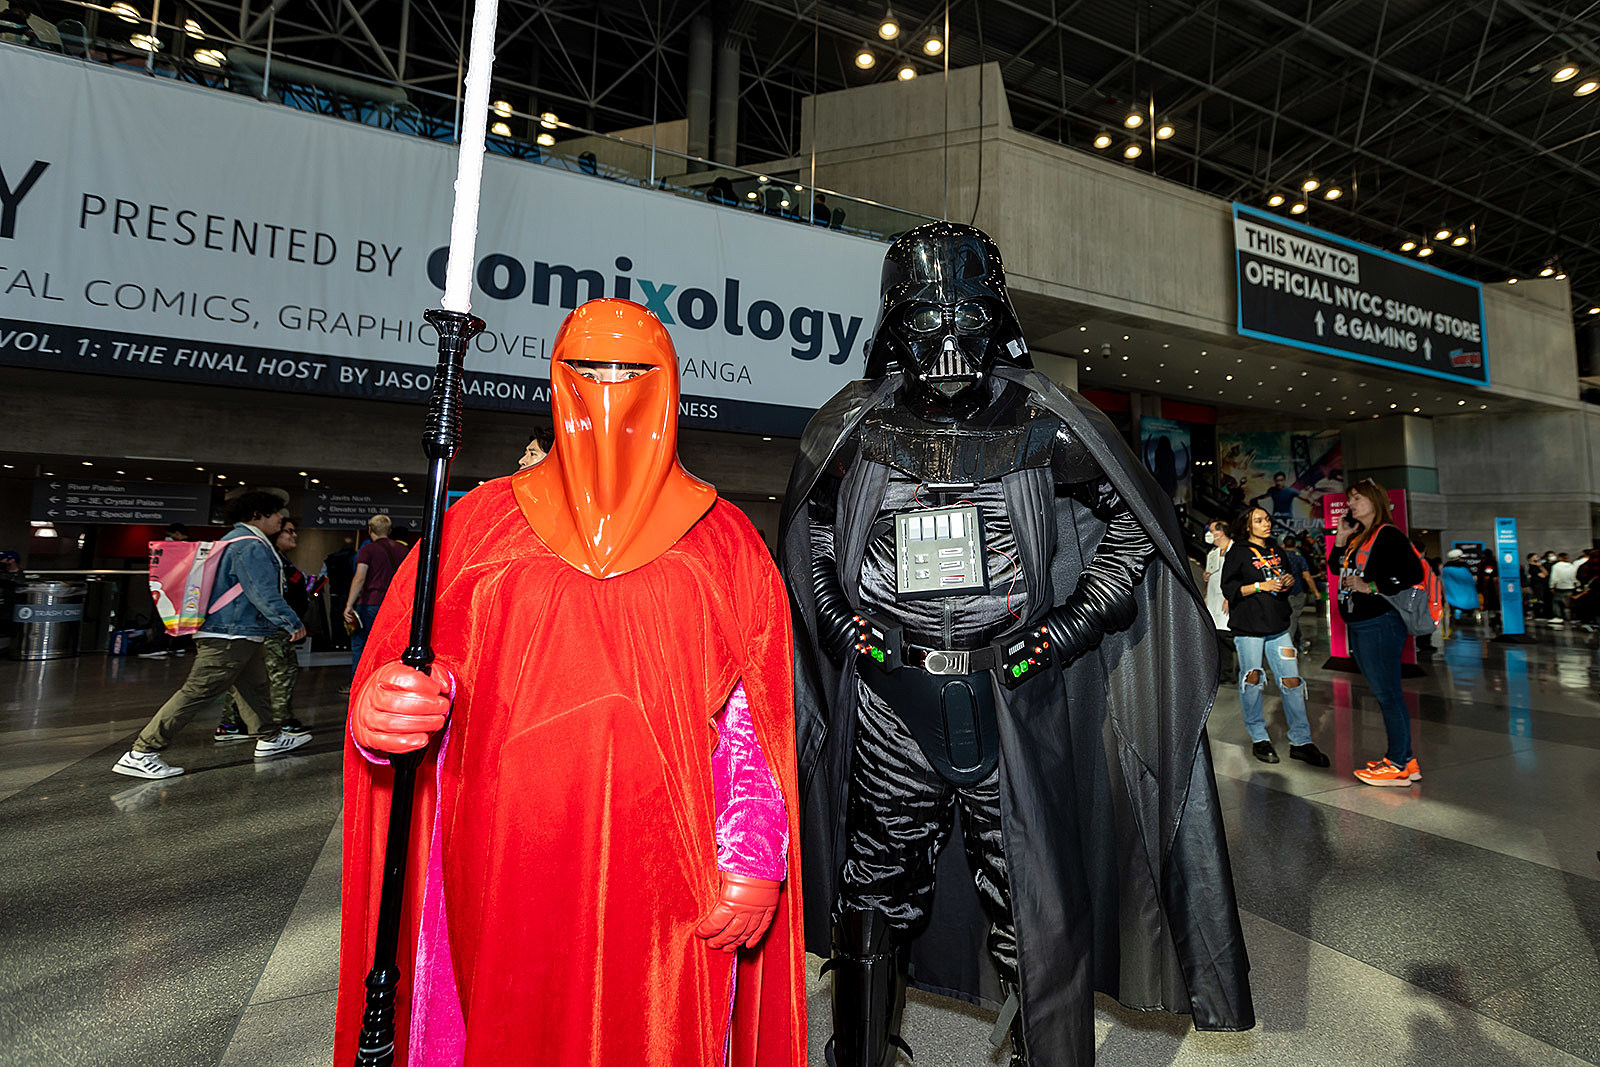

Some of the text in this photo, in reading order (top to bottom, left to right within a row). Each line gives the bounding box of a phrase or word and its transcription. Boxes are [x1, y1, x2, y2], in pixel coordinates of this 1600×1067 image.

[79, 192, 338, 267] PRESENTED
[355, 239, 403, 277] BY
[1245, 227, 1356, 276] THIS WAY TO:
[1245, 262, 1481, 344] OFFICIAL NYCC SHOW STORE
[85, 279, 260, 330] COMICS,
[278, 305, 436, 347] GRAPHIC
[466, 330, 553, 360] OVEL
[677, 356, 752, 385] ANGA
[1333, 312, 1418, 353] & GAMING
[77, 337, 101, 358] 1:
[111, 341, 164, 366] THE
[172, 349, 248, 374] FINAL
[257, 357, 326, 381] HOST
[339, 366, 370, 386] BY
[374, 368, 435, 392] JASO
[91, 483, 126, 493] Pavilion
[103, 497, 135, 507] Crystal
[135, 498, 165, 507] Palace
[101, 510, 133, 520] Special
[134, 511, 163, 520] Events
[339, 518, 367, 527] Meeting
[35, 609, 63, 617] TRASH
